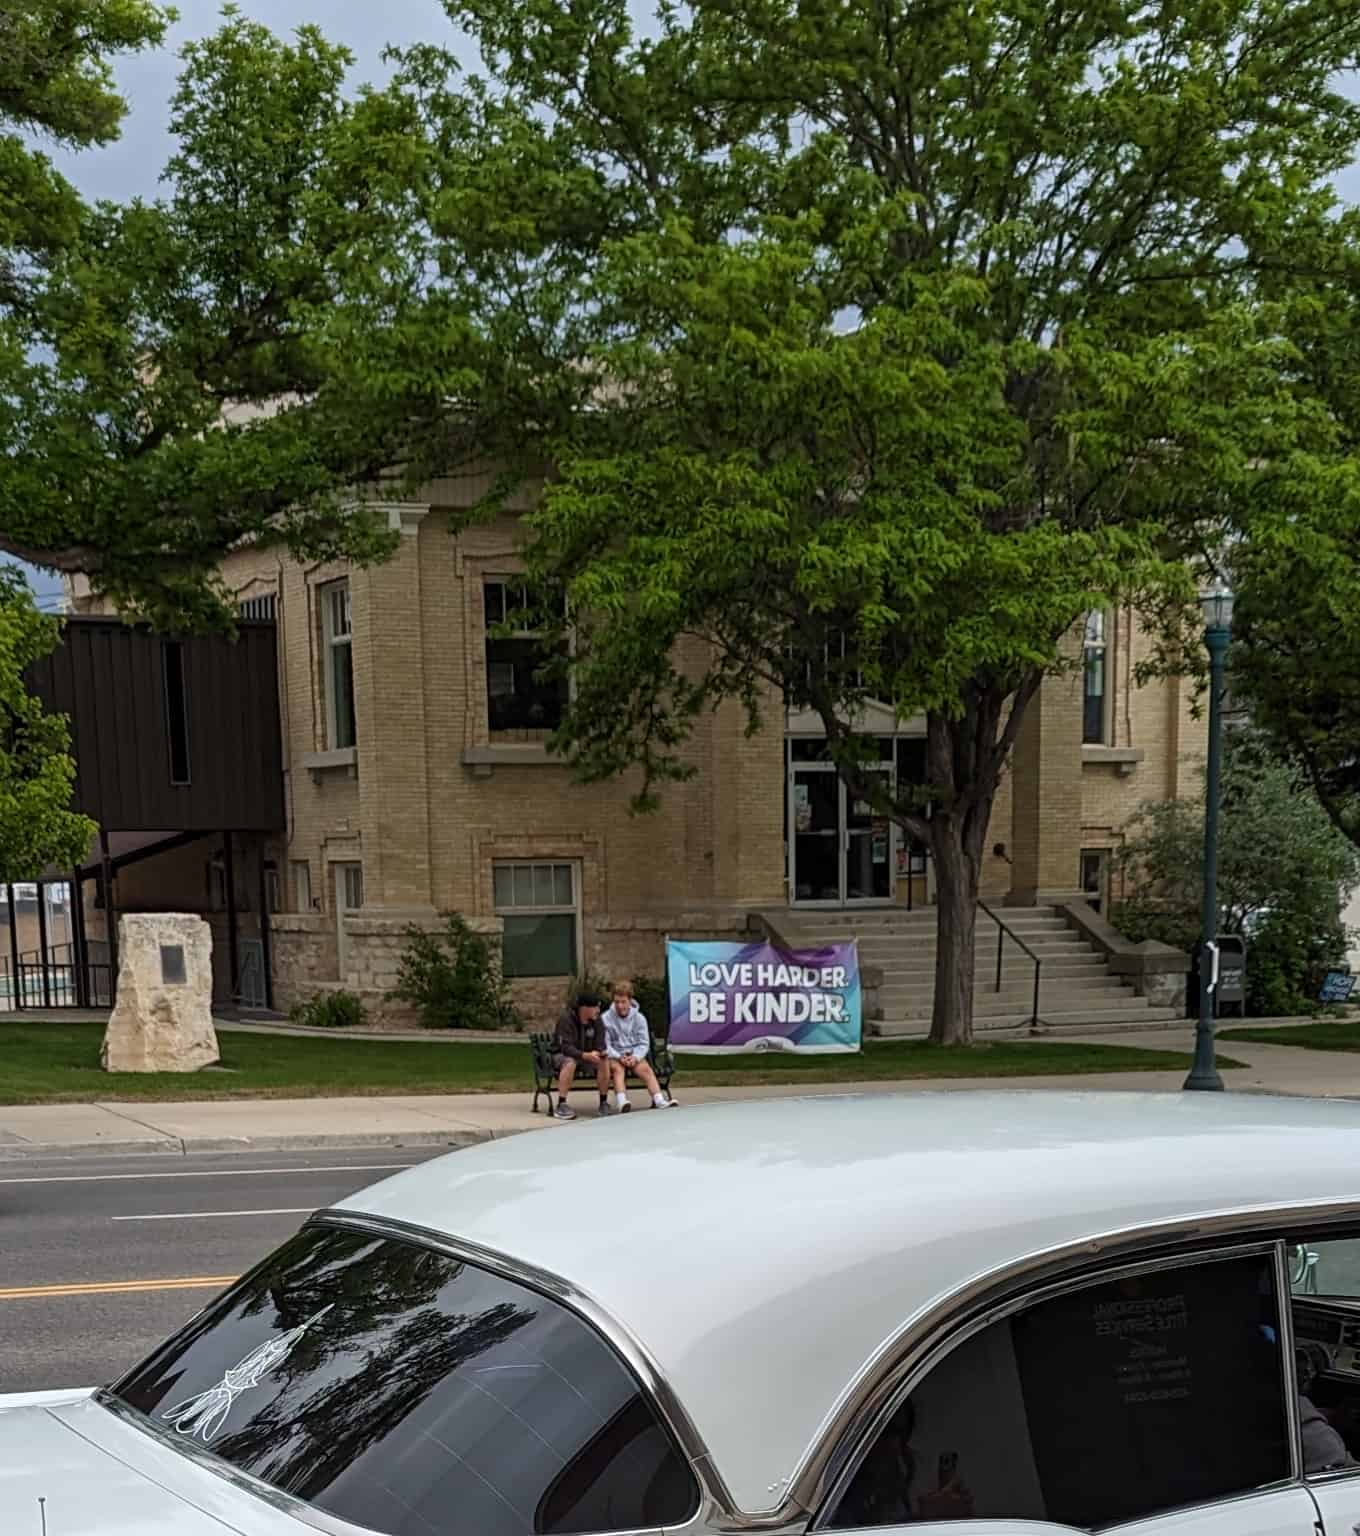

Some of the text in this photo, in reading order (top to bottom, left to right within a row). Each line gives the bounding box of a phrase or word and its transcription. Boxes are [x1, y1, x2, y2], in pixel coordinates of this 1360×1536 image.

[689, 962, 849, 989] LOVE HARDER.
[689, 992, 850, 1023] BE KINDER.
